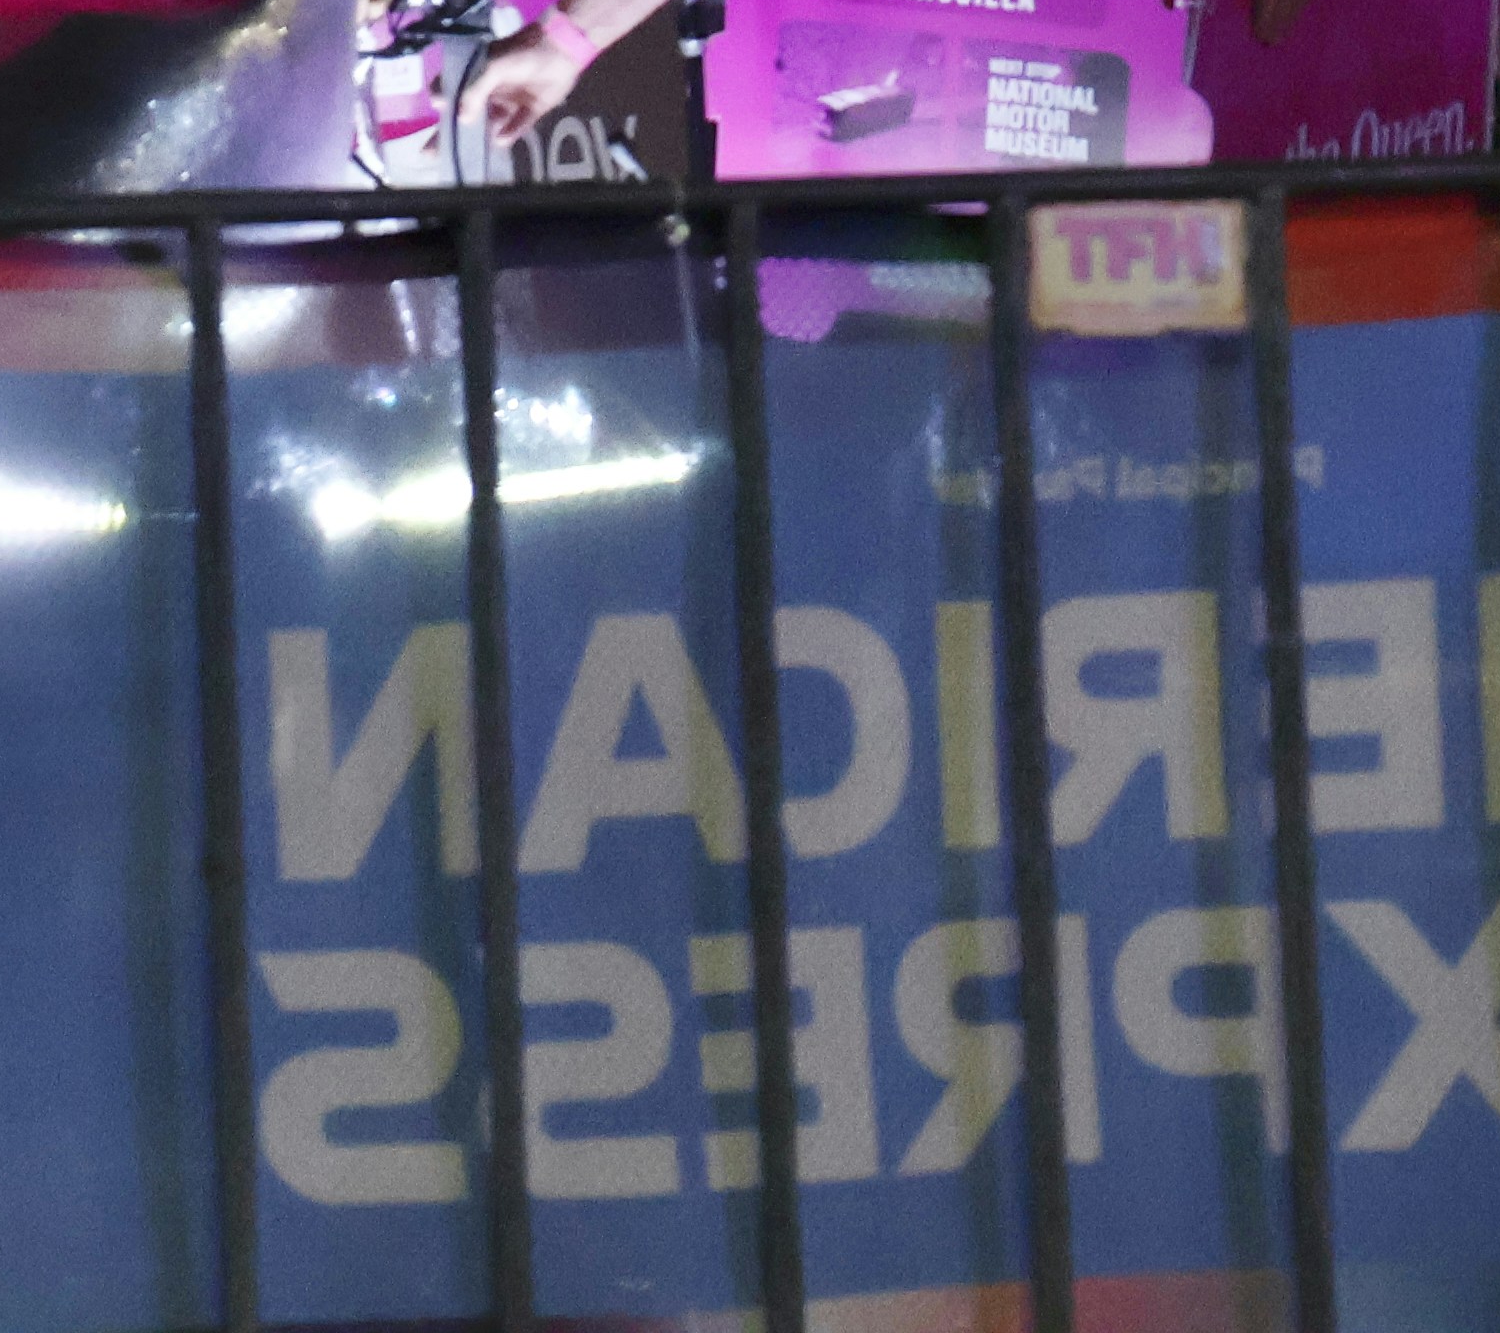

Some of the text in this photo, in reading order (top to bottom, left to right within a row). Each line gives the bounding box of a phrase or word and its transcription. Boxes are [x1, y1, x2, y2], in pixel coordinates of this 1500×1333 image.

[987, 77, 1099, 116] NATIONAL
[986, 102, 1070, 135] MOTOR
[984, 127, 1090, 163] MUSEUM
[1055, 217, 1221, 282] TFH
